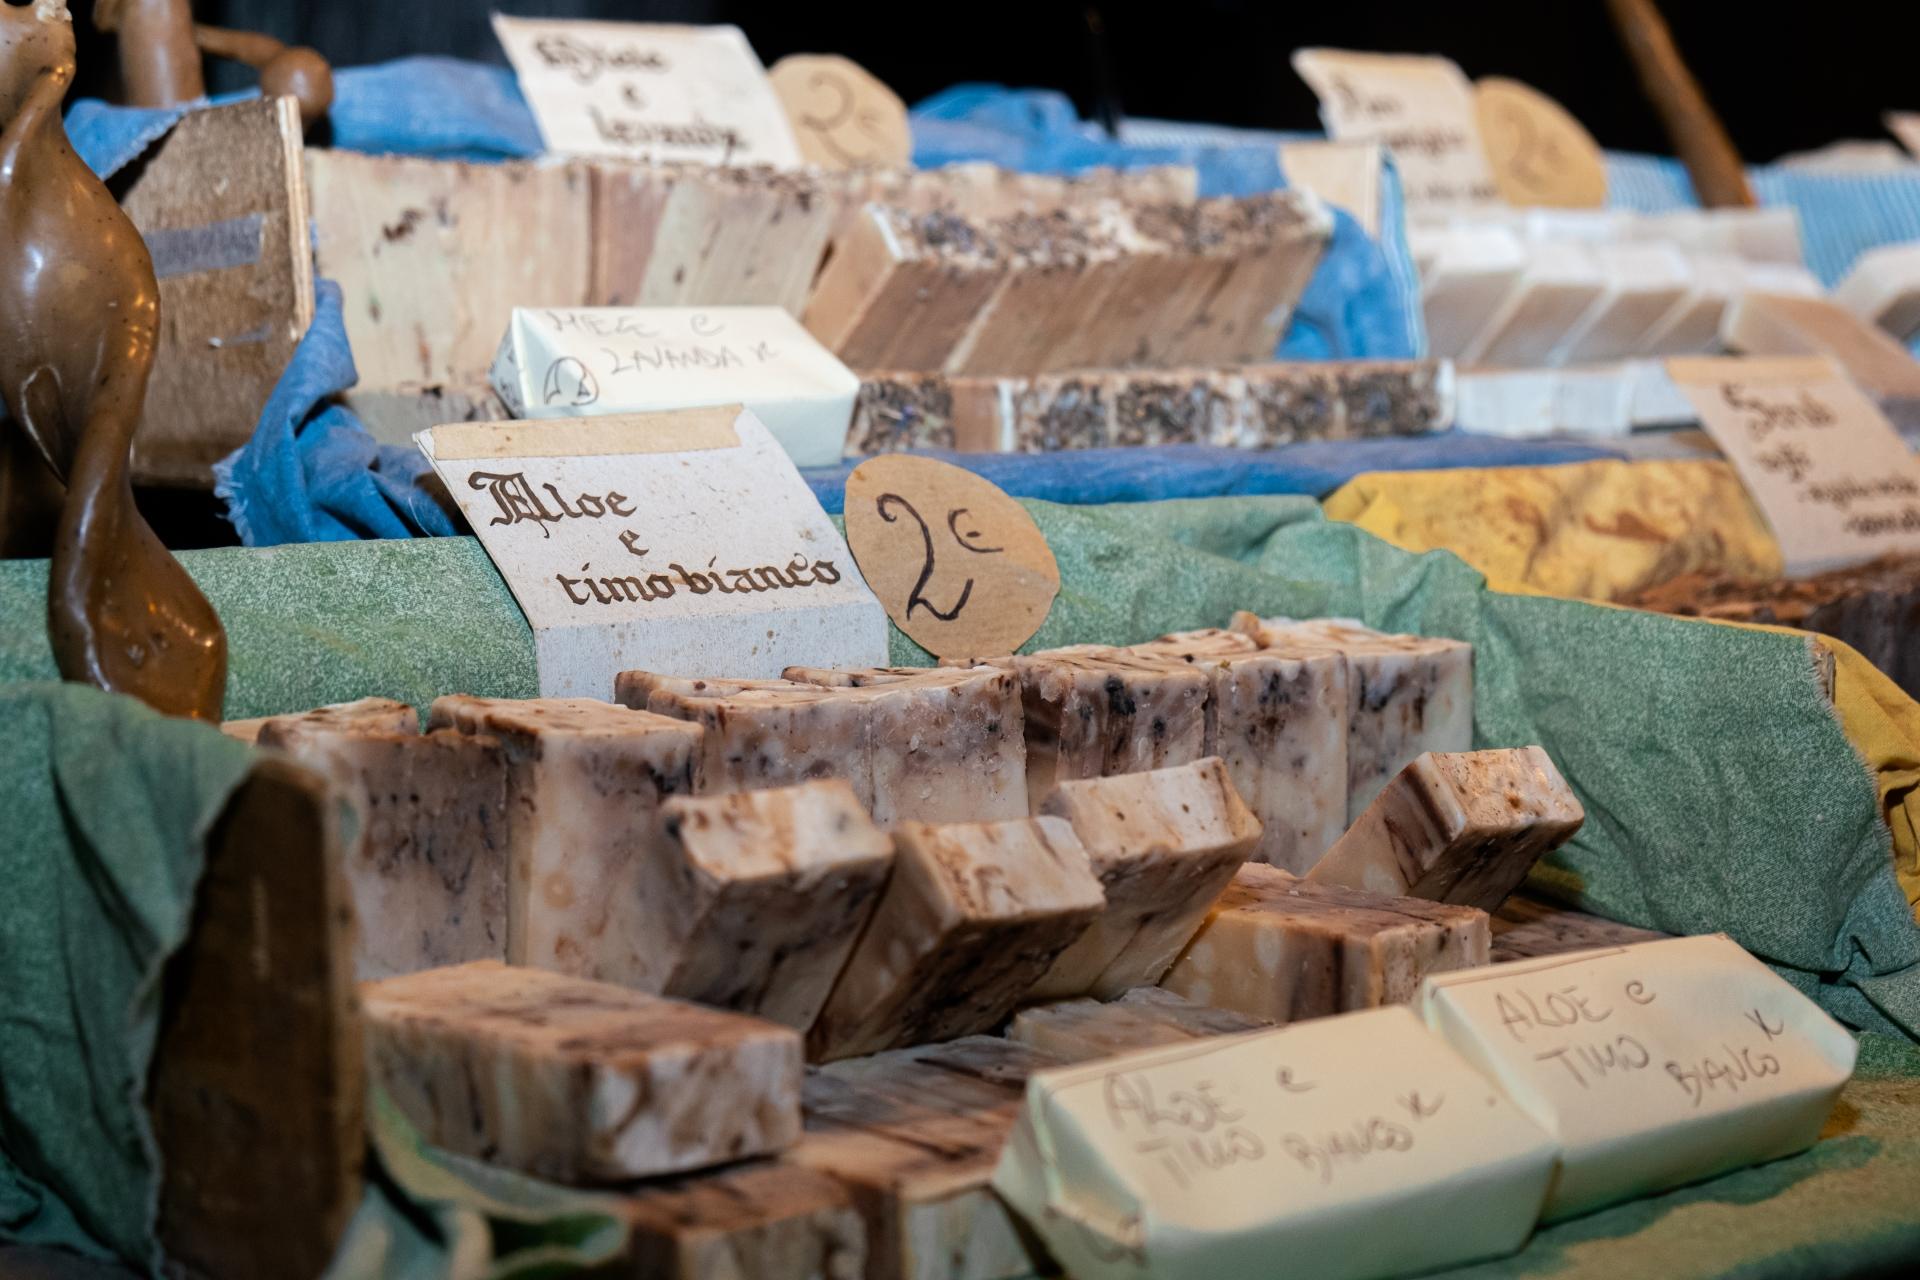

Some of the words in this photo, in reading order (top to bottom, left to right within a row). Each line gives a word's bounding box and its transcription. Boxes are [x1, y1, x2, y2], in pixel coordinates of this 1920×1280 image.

[468, 471, 638, 538] Aloe
[618, 529, 650, 557] e
[1494, 984, 1615, 1043] ALOE
